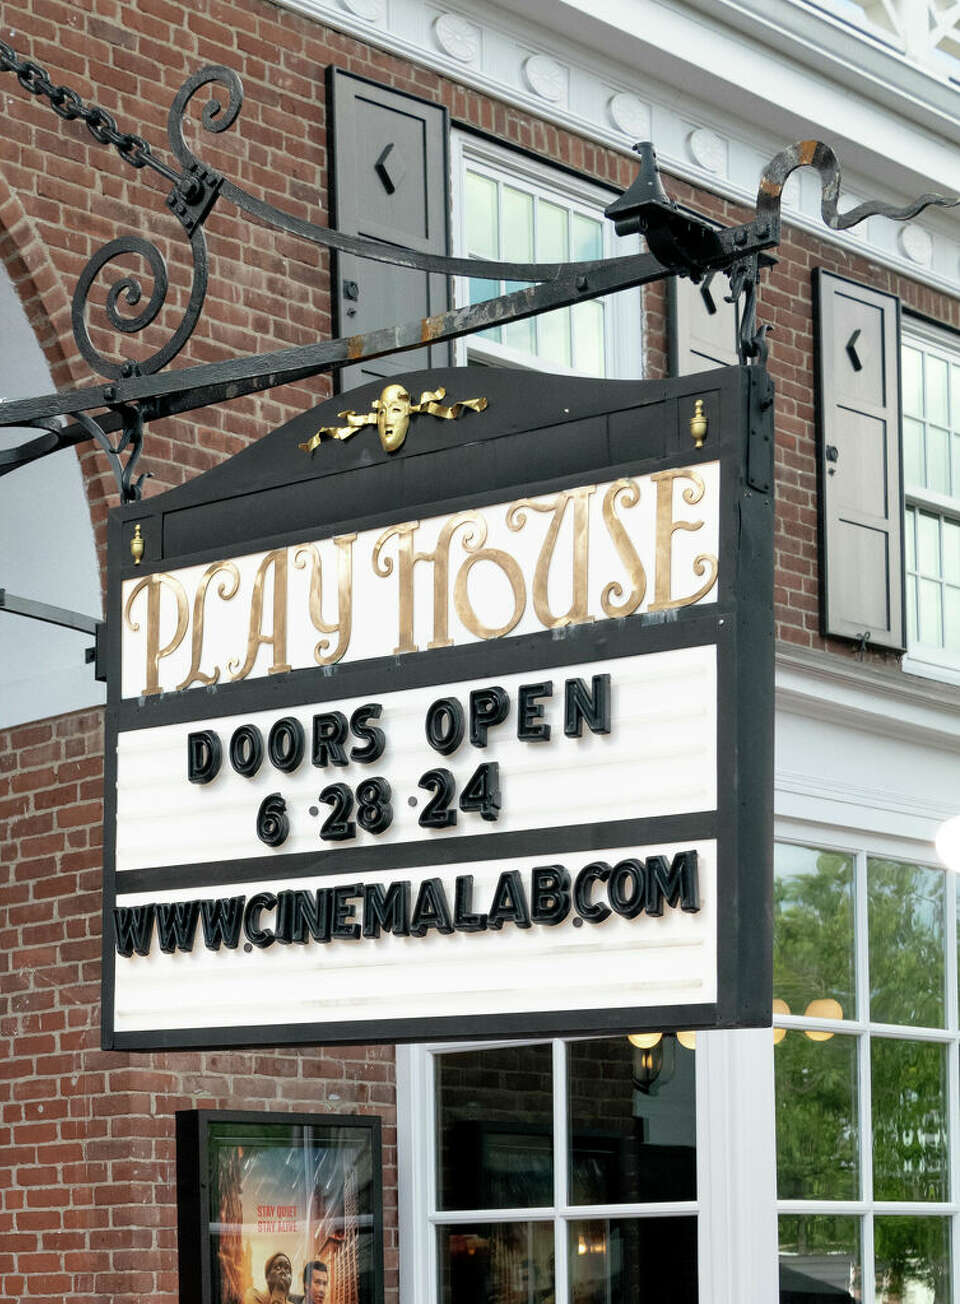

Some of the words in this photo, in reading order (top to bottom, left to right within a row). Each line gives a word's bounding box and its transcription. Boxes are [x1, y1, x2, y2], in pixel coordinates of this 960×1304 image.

[125, 468, 720, 696] PLAYHOUSE
[187, 702, 384, 785] DOORS
[425, 673, 612, 756] OPEN
[257, 1204, 274, 1218] STAY
[276, 1204, 297, 1219] QUIET
